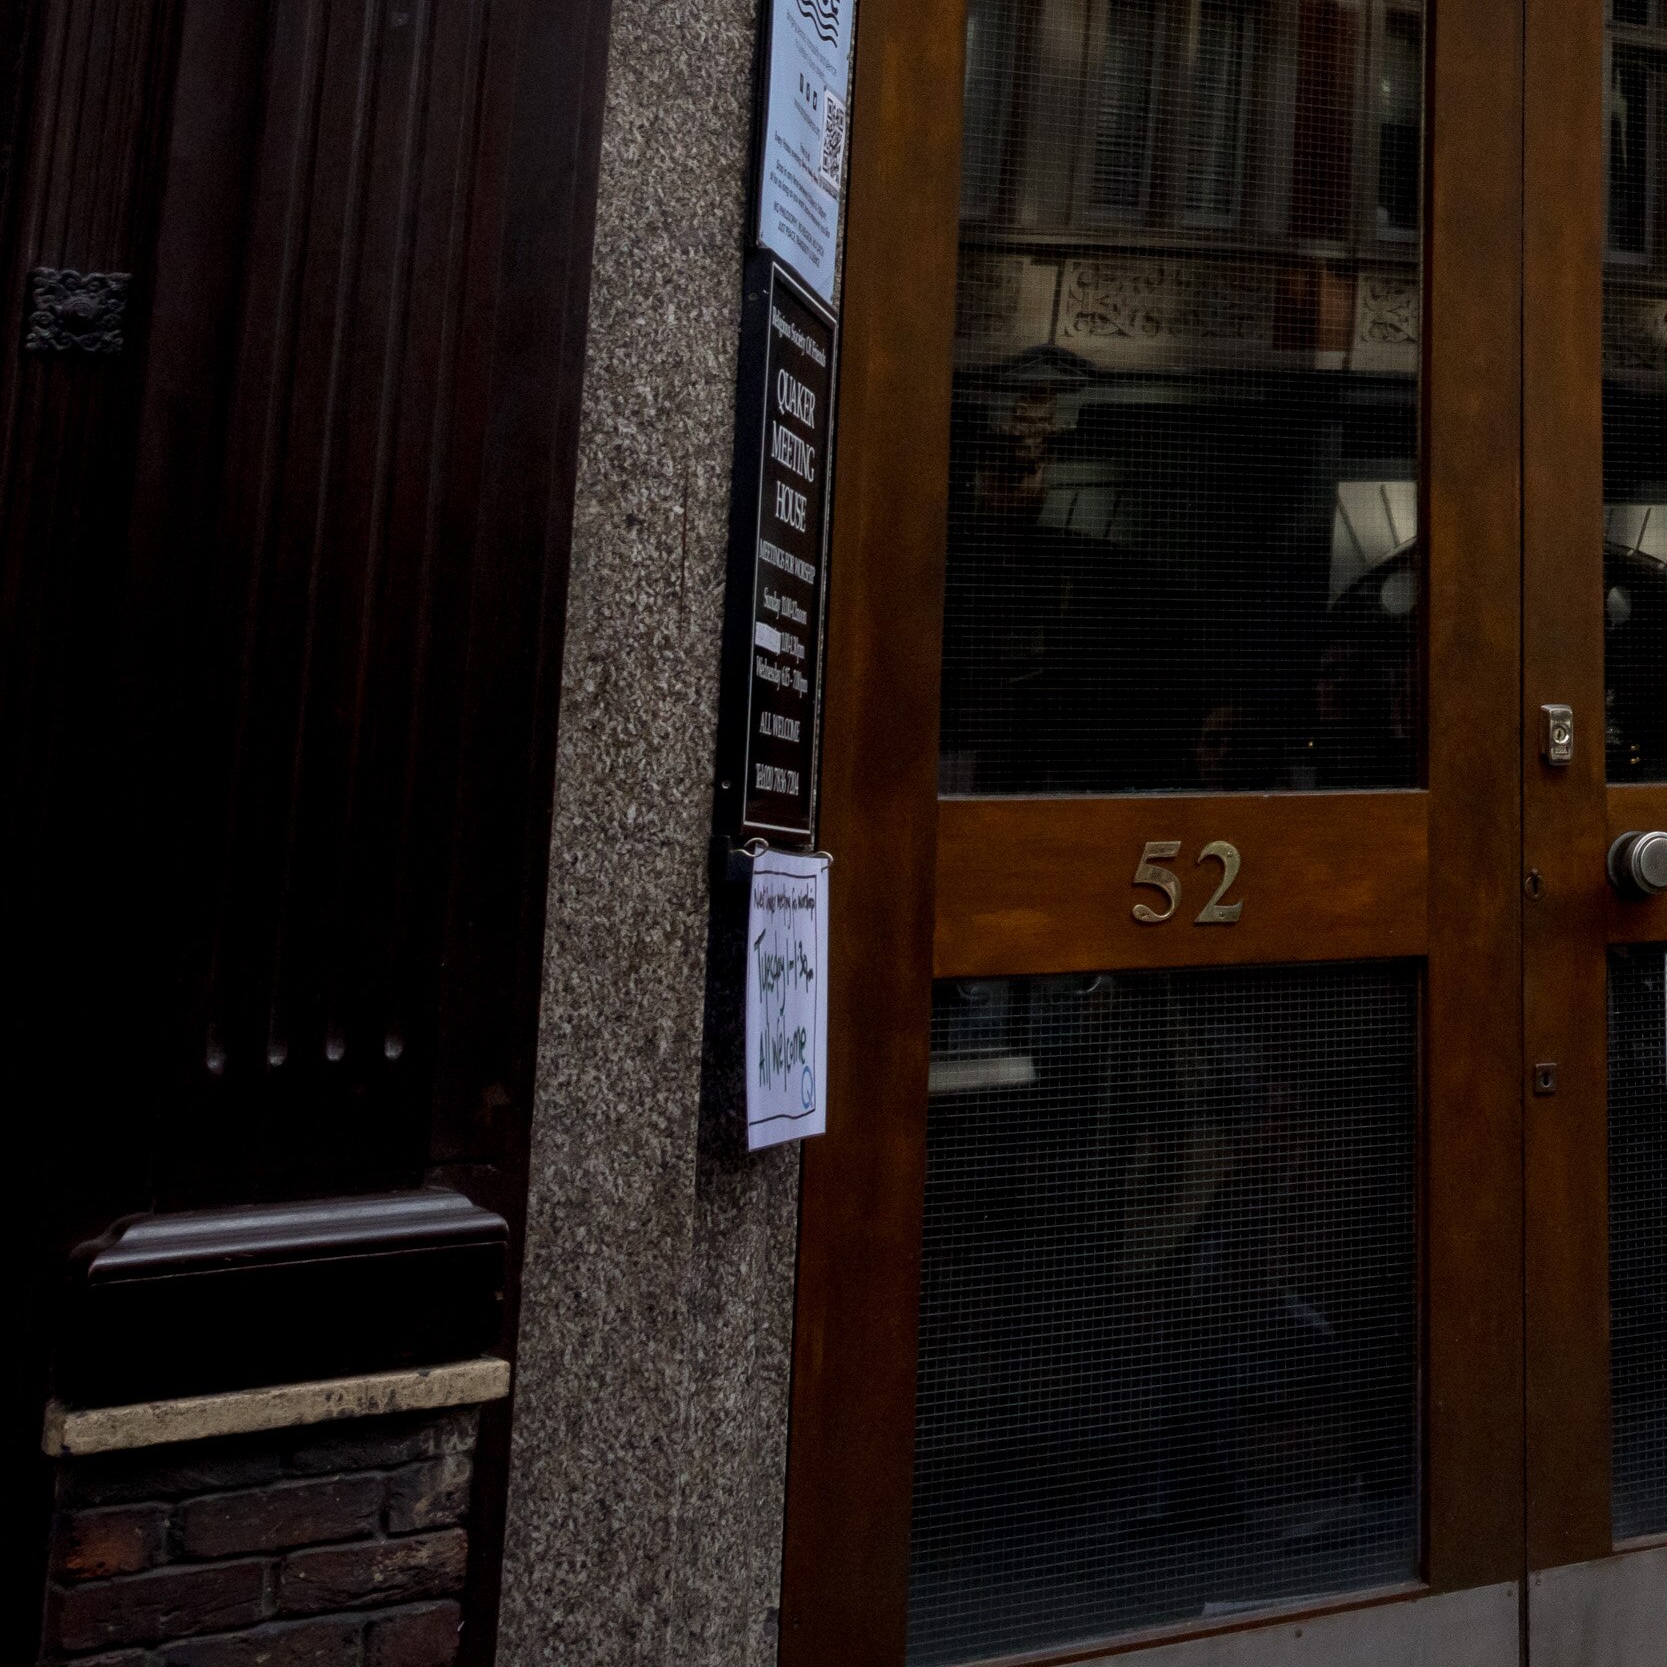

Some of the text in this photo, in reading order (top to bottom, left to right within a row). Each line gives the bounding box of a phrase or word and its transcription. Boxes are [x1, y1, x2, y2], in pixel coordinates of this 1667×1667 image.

[777, 368, 816, 429] QUAKER
[771, 419, 815, 482] MEETING
[775, 480, 807, 532] HOUSE
[1131, 840, 1245, 923] 52
